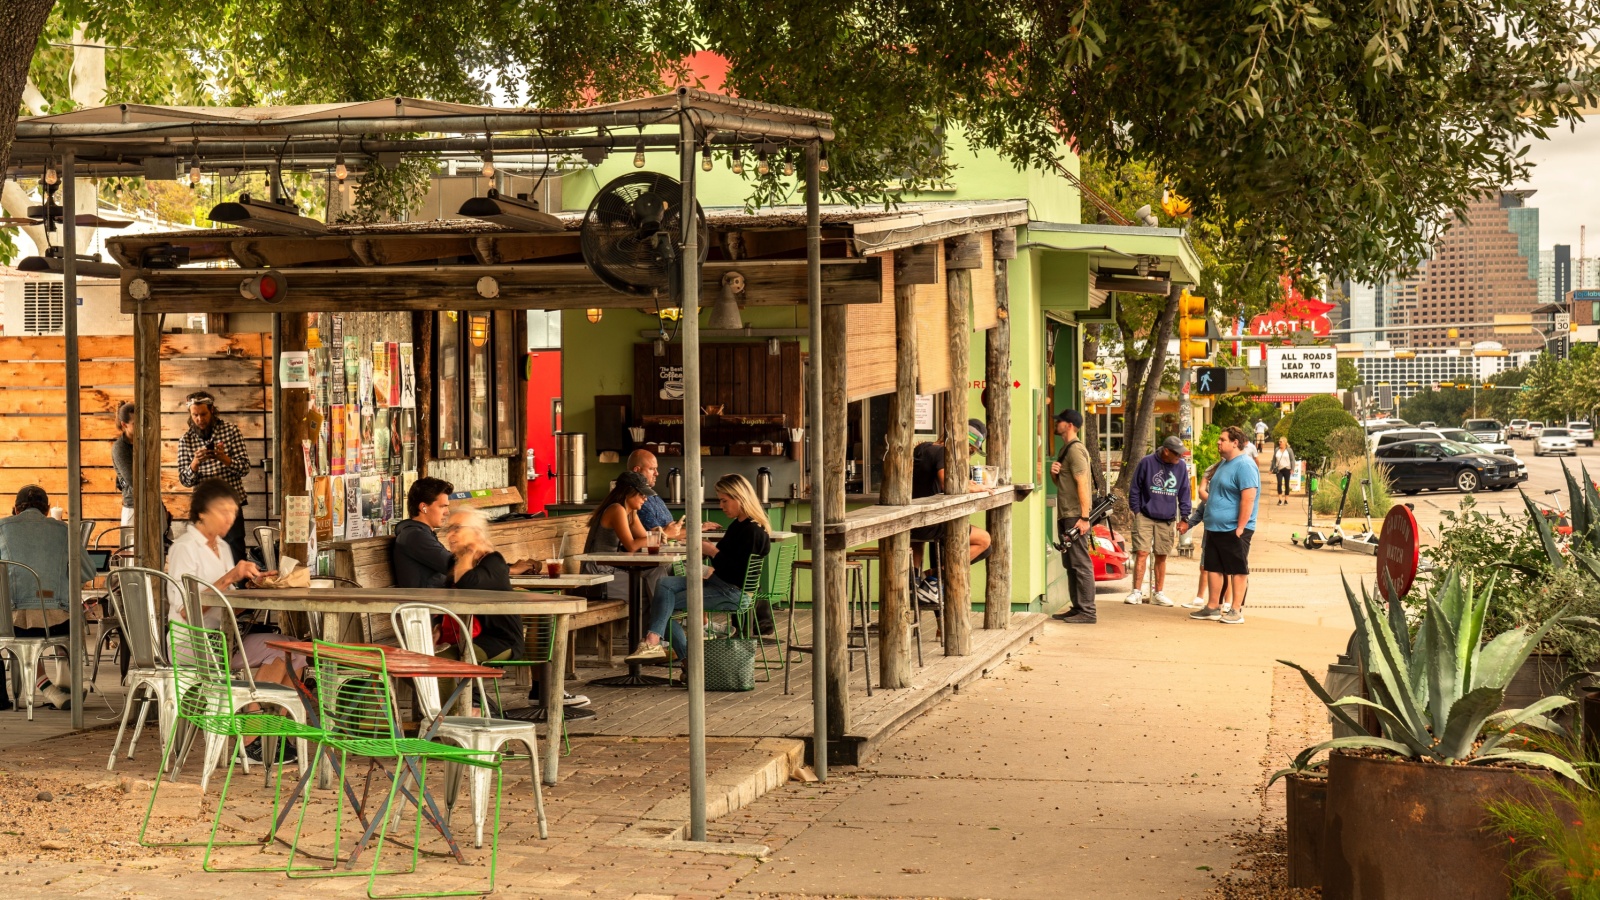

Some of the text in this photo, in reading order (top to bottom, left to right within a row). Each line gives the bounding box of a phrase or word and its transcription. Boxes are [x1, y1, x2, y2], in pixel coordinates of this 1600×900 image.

[1557, 322, 1568, 330] 30
[660, 372, 684, 381] Coffee
[1386, 514, 1411, 542] CAUTION
[1386, 543, 1404, 564] WATCH
